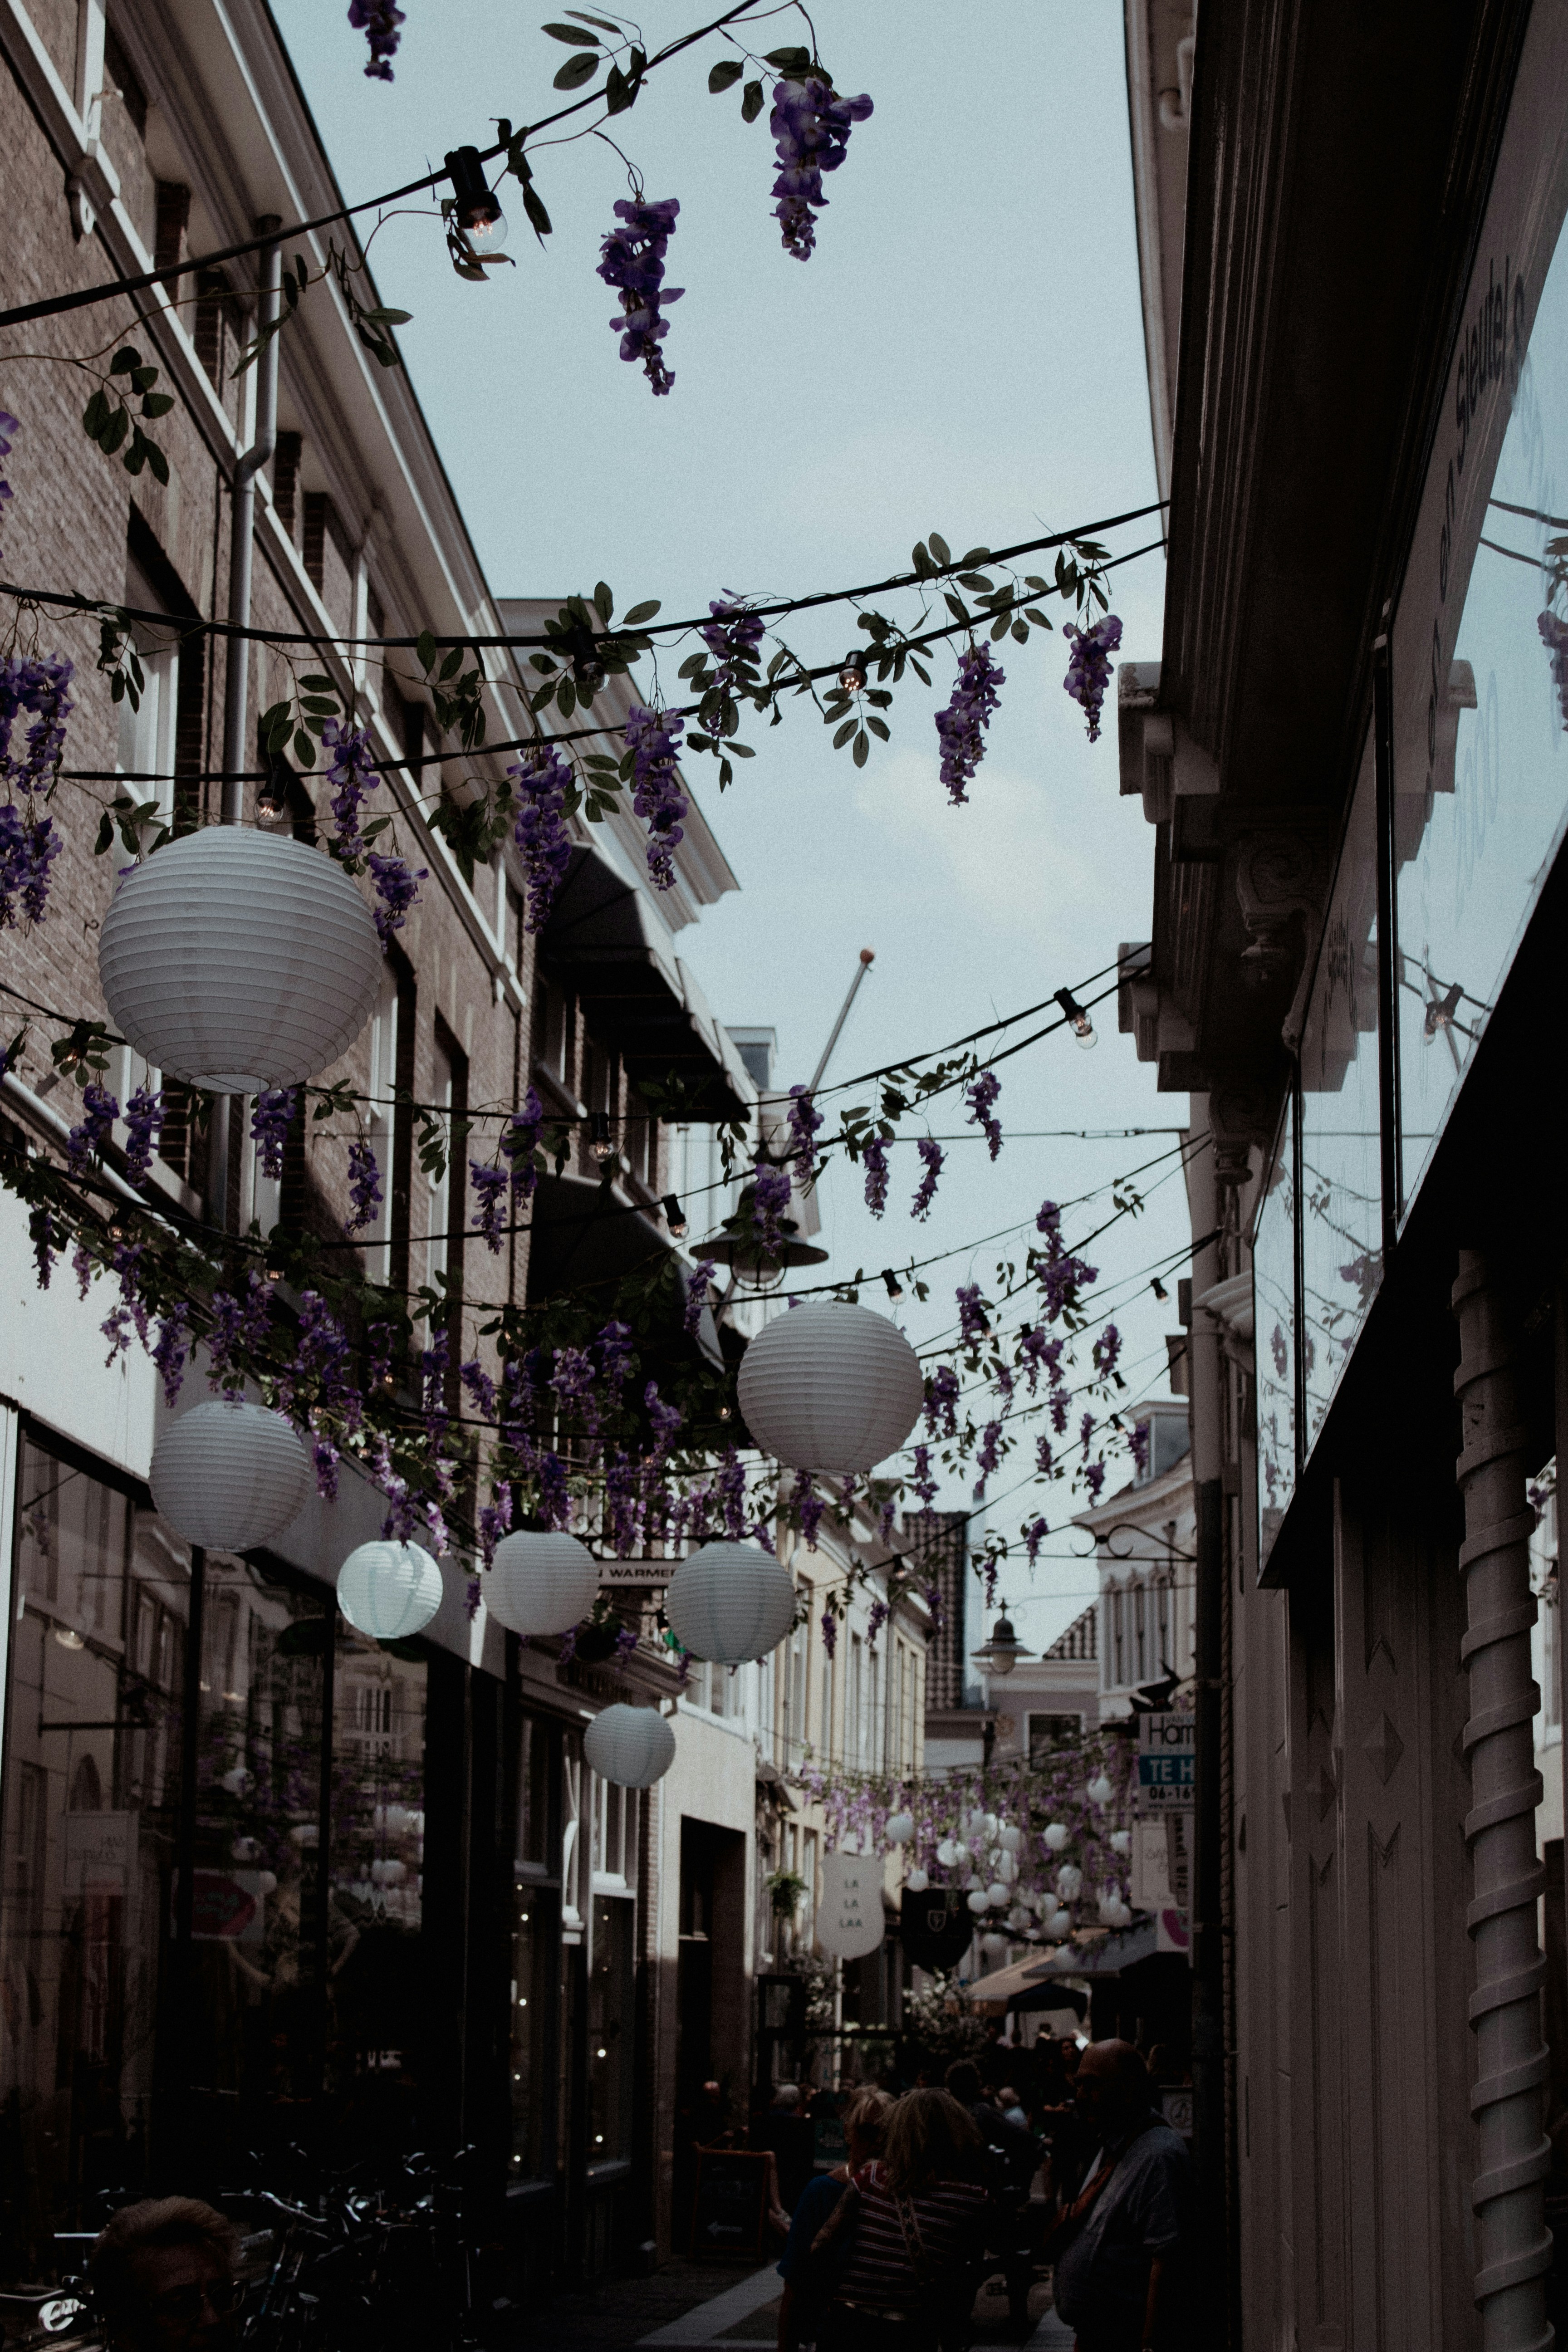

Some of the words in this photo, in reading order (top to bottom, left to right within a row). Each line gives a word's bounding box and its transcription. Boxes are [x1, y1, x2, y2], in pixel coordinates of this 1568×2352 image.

[1150, 1759, 1172, 1782] TE
[1150, 1786, 1195, 1800] 06-16
[844, 1879, 859, 1889] LA
[843, 1899, 859, 1909] LA
[839, 1918, 862, 1928] LAA
